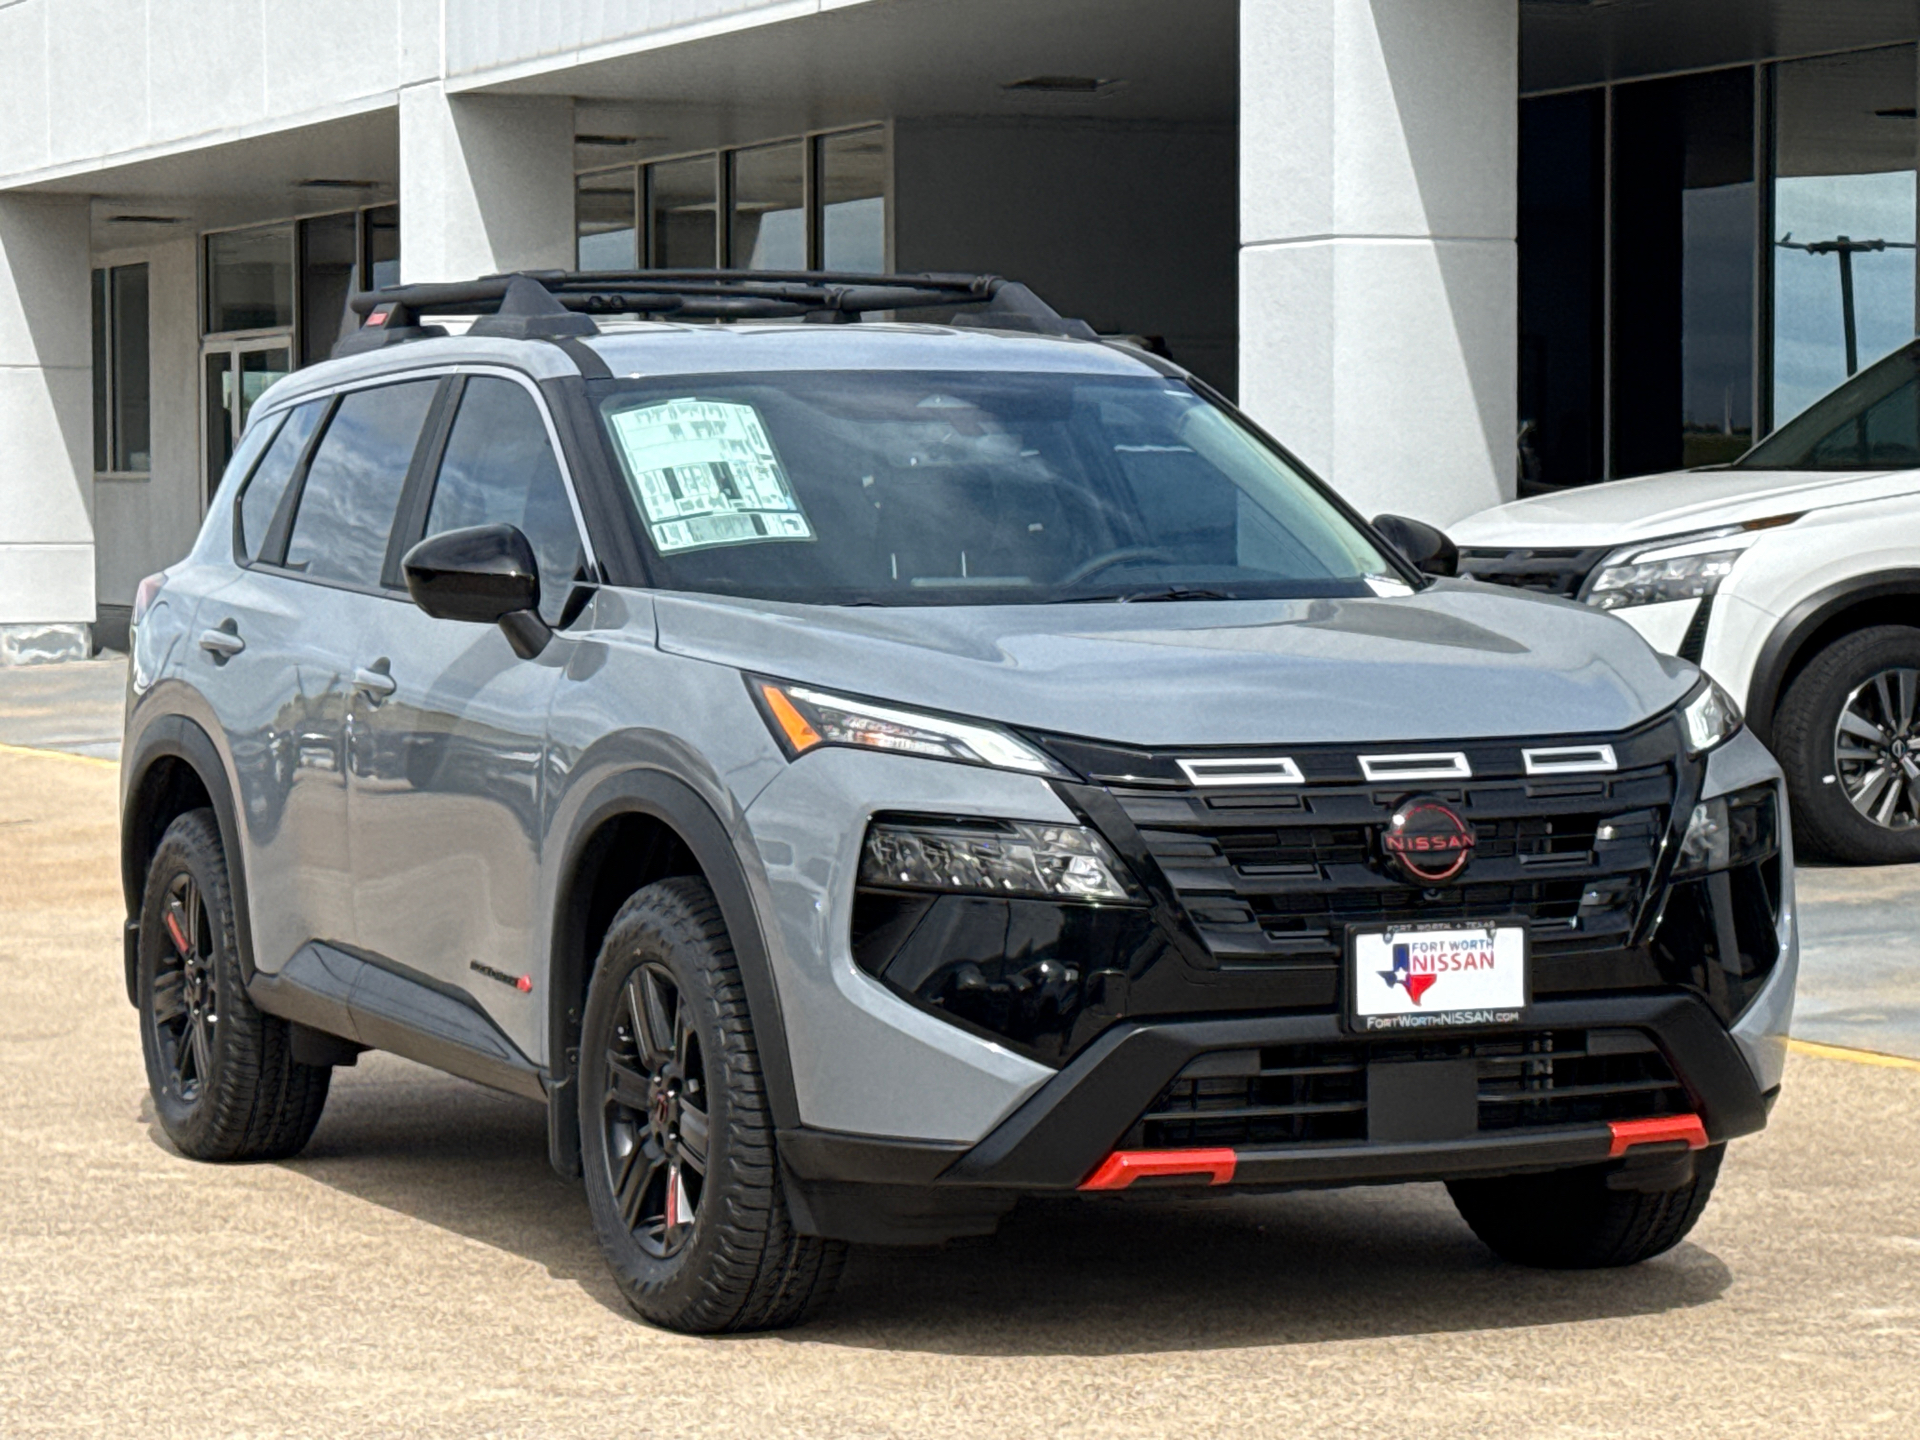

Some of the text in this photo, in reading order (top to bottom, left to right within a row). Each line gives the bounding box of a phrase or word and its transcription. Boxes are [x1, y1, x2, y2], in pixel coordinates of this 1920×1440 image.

[1385, 834, 1475, 851] NISSAN
[1412, 939, 1495, 953] FORT WORTH
[1412, 951, 1495, 972] NISSAN
